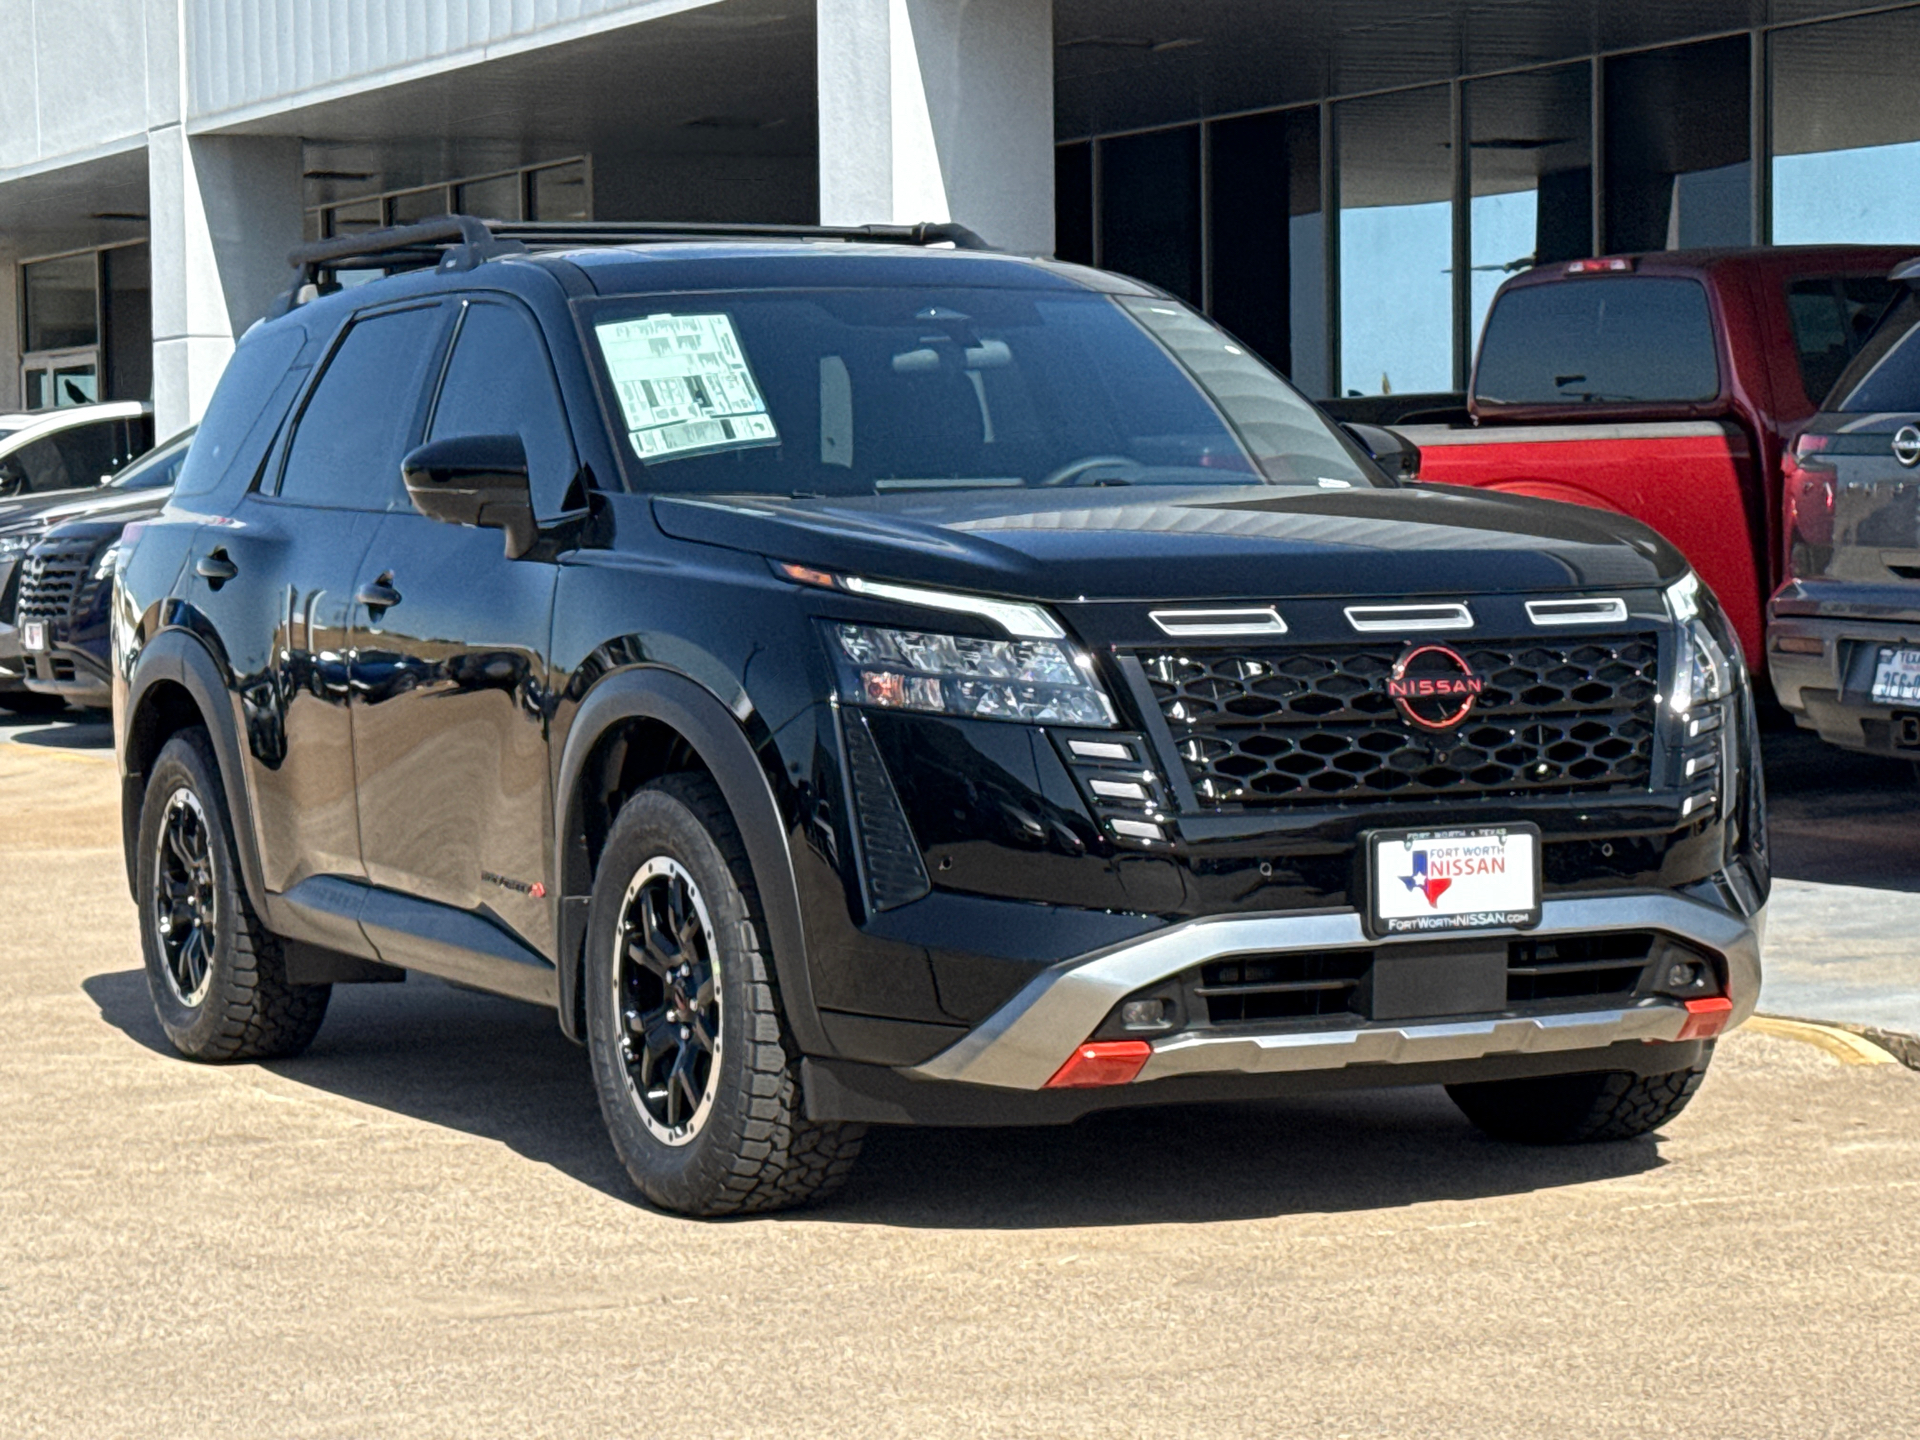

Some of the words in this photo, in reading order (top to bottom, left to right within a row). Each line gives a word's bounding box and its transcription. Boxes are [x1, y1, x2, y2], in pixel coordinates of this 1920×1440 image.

[1389, 678, 1482, 696] NISSAN
[1407, 832, 1431, 840] FORT
[1434, 830, 1466, 839] WORTH
[1479, 828, 1507, 837] TEXAS
[1430, 847, 1460, 858] FORT
[1463, 845, 1505, 856] WORTH
[1430, 856, 1505, 877] NISSAN
